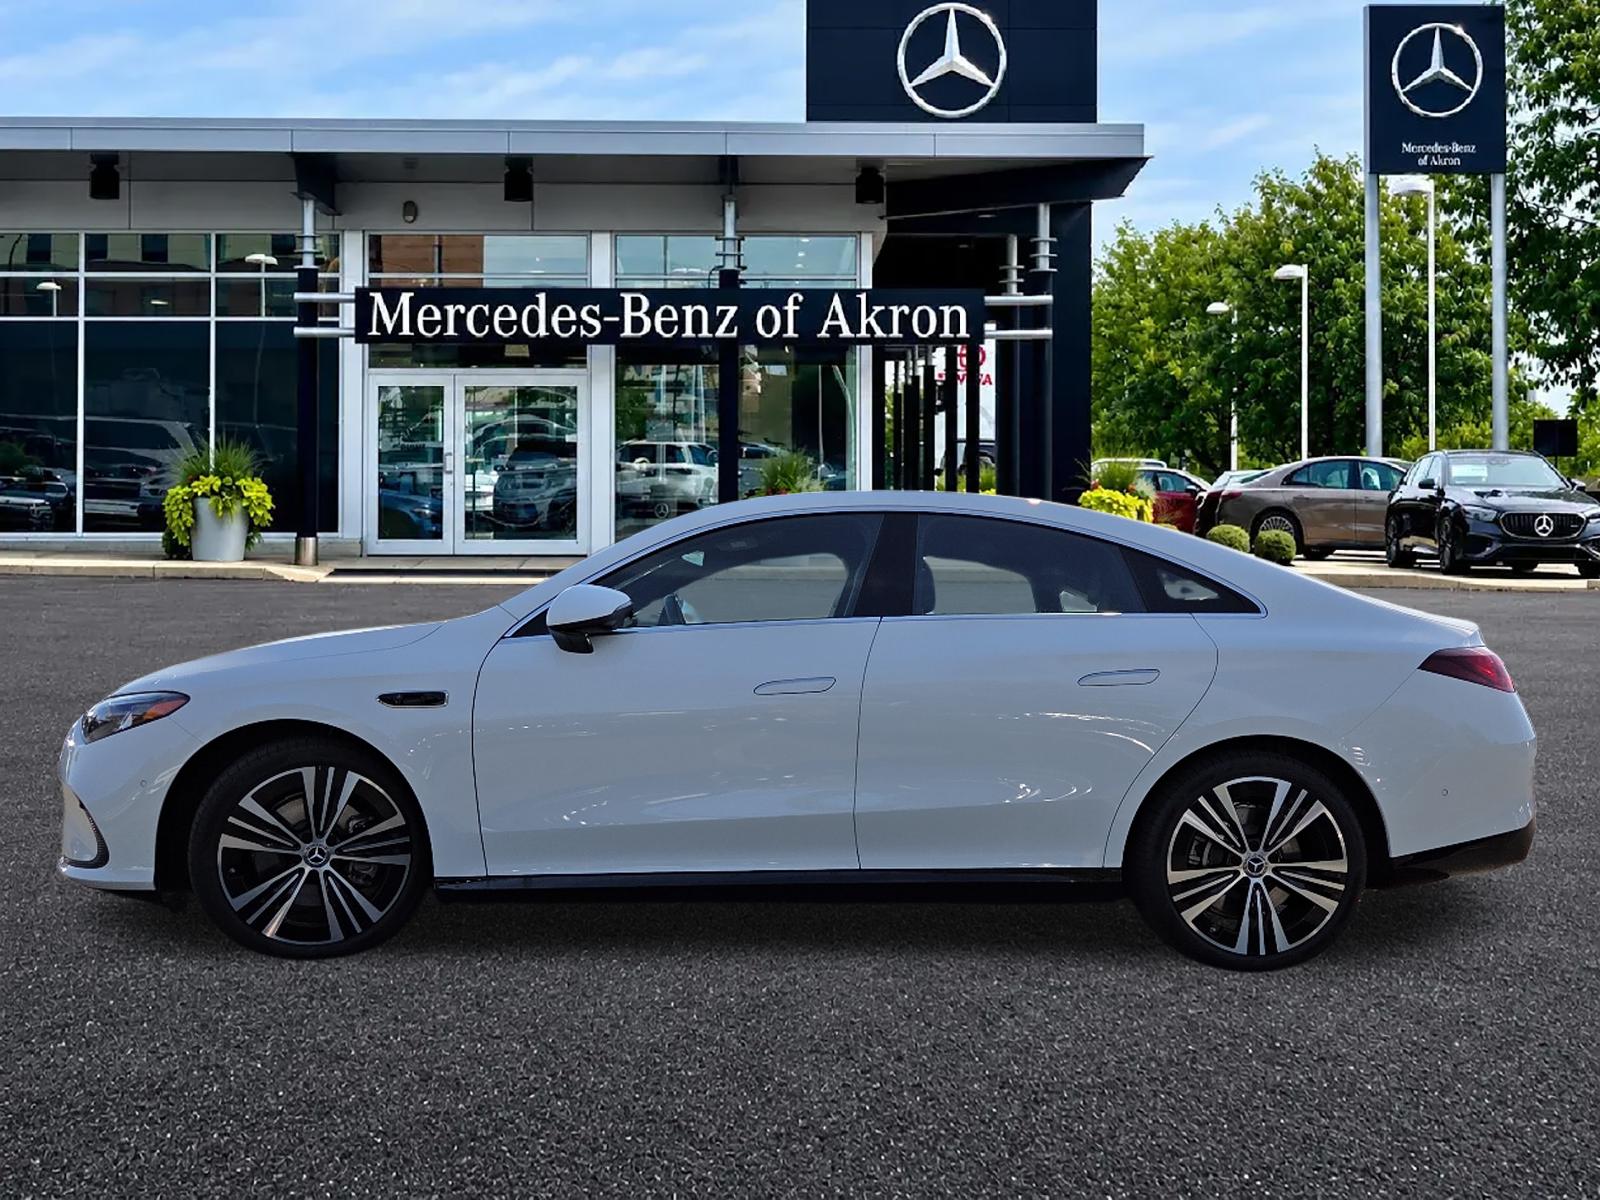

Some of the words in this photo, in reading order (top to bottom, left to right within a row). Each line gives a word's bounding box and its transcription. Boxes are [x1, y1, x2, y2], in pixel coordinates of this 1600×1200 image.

[1401, 141, 1476, 154] Mercedes-Benz
[1417, 154, 1428, 166] of
[1430, 154, 1461, 166] Akron
[367, 291, 738, 338] Mercedes-Benz
[755, 291, 804, 339] of
[816, 291, 971, 339] Akron
